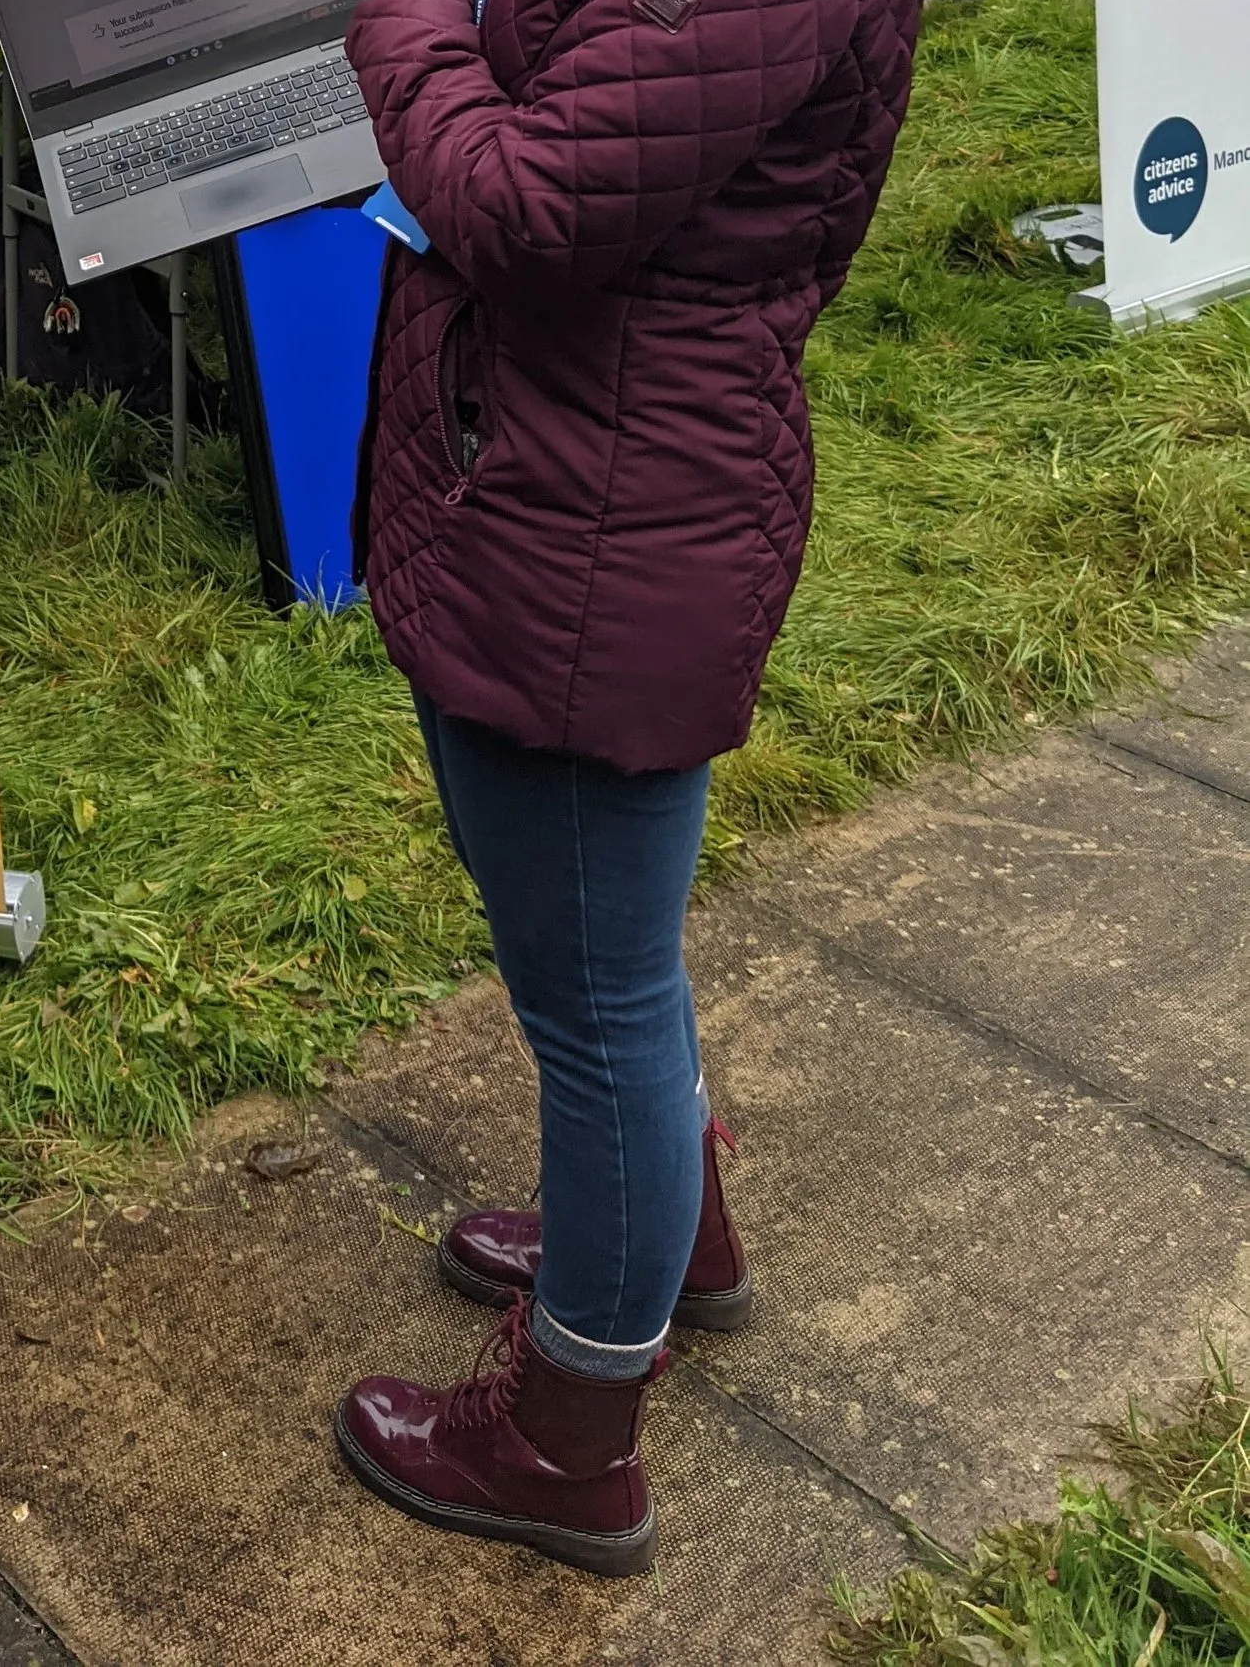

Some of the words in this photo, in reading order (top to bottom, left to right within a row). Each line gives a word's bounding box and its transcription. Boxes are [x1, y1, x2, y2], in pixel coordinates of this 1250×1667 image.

[110, 16, 127, 28] Your
[129, 2, 172, 21] submission
[114, 18, 155, 40] successful
[1143, 152, 1198, 182] citizens
[1148, 177, 1195, 204] advice
